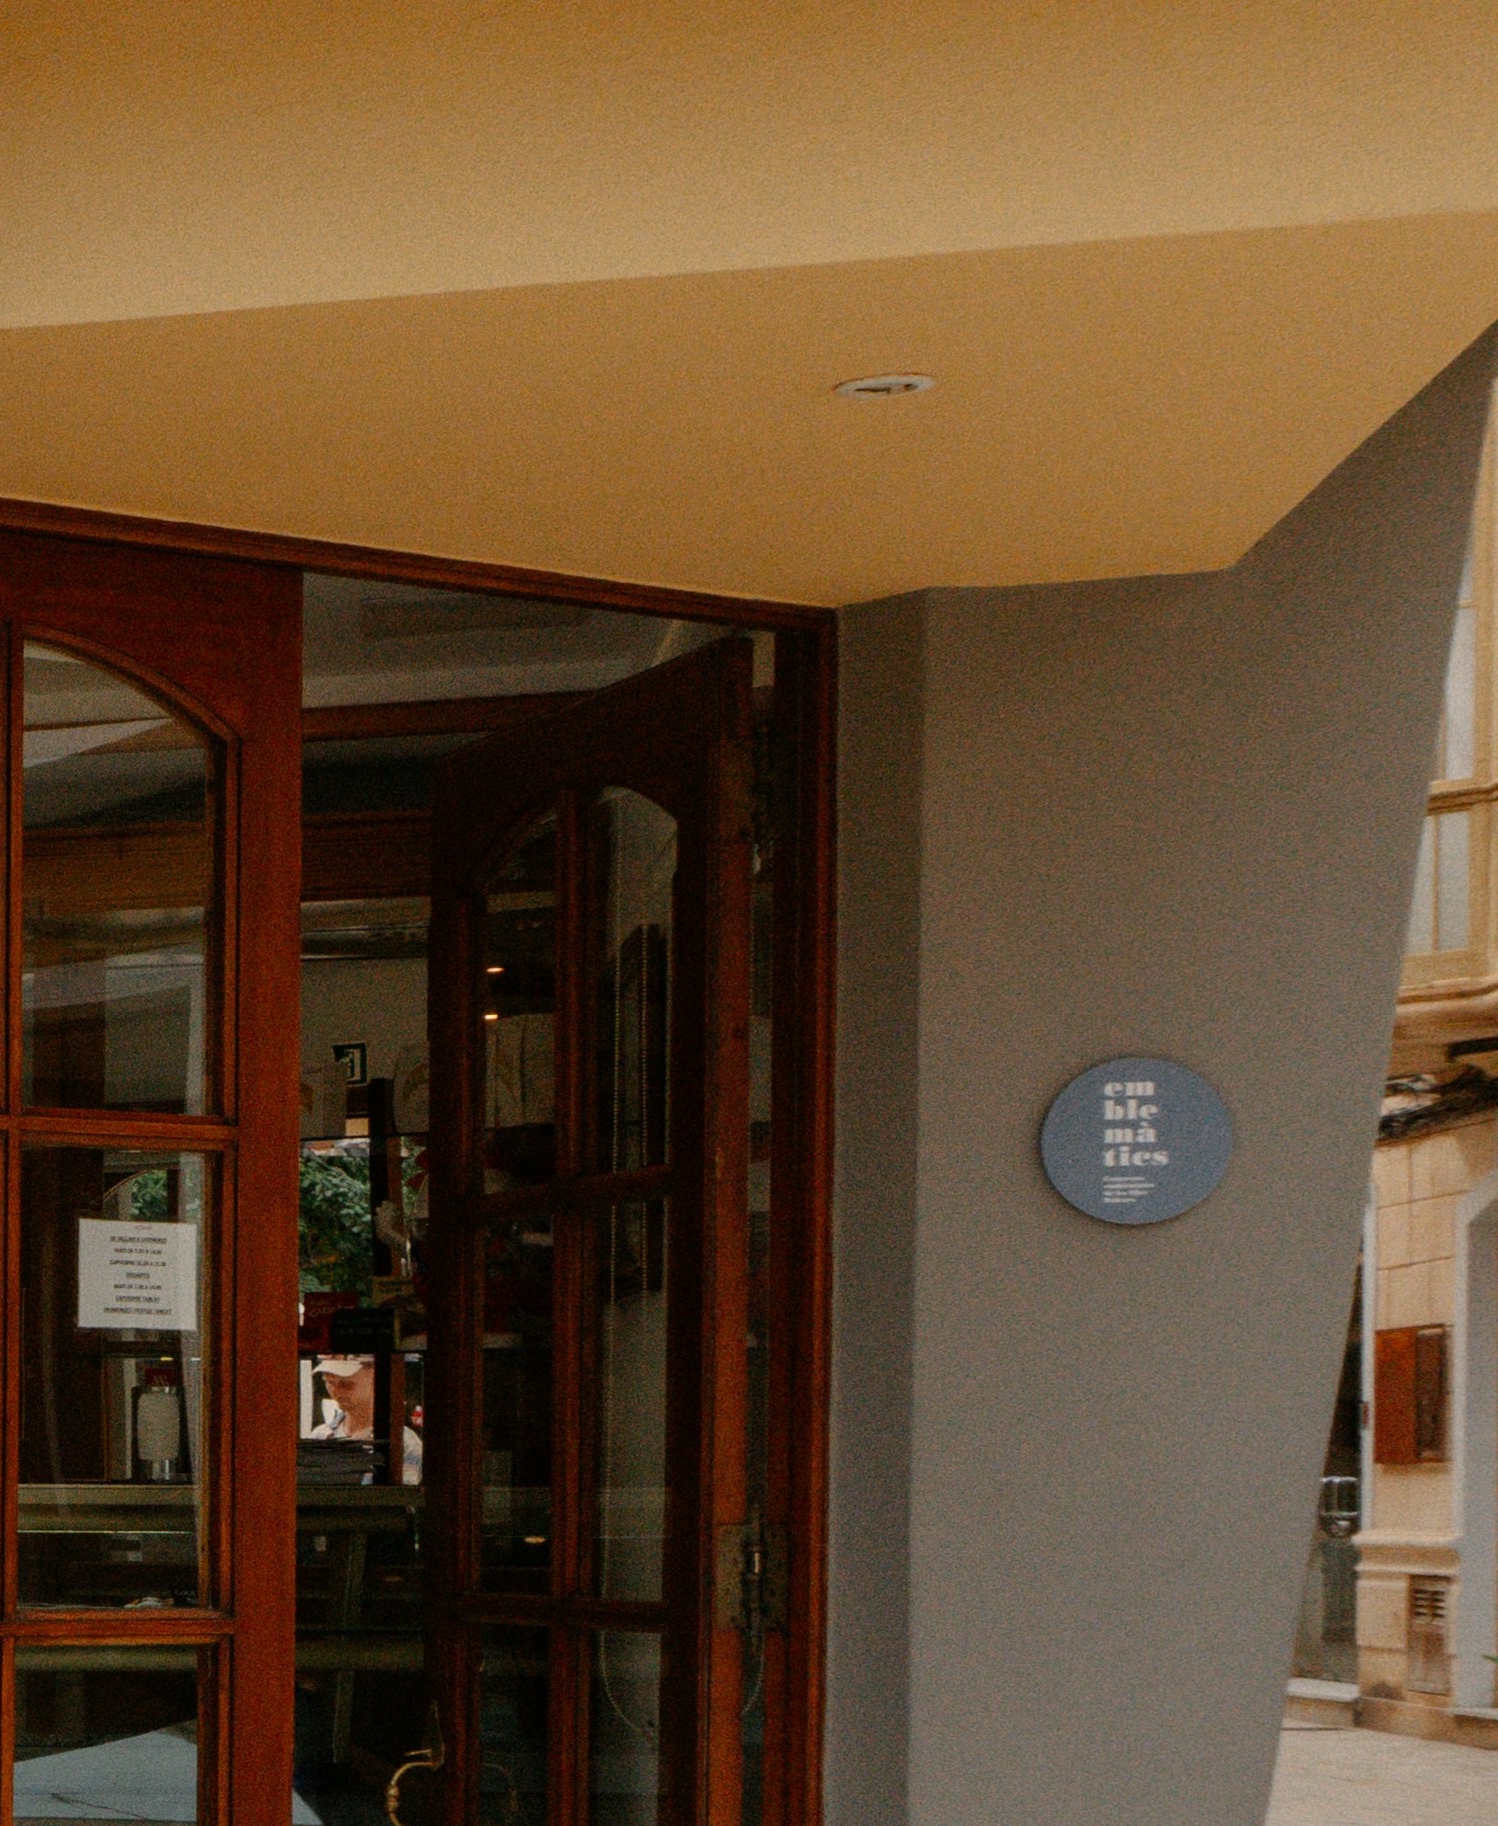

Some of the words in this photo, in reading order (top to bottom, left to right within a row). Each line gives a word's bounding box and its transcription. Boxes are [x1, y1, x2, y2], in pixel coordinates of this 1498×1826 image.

[1104, 1081, 1156, 1097] em
[1103, 1099, 1159, 1120] ble
[1103, 1146, 1170, 1167] tics
